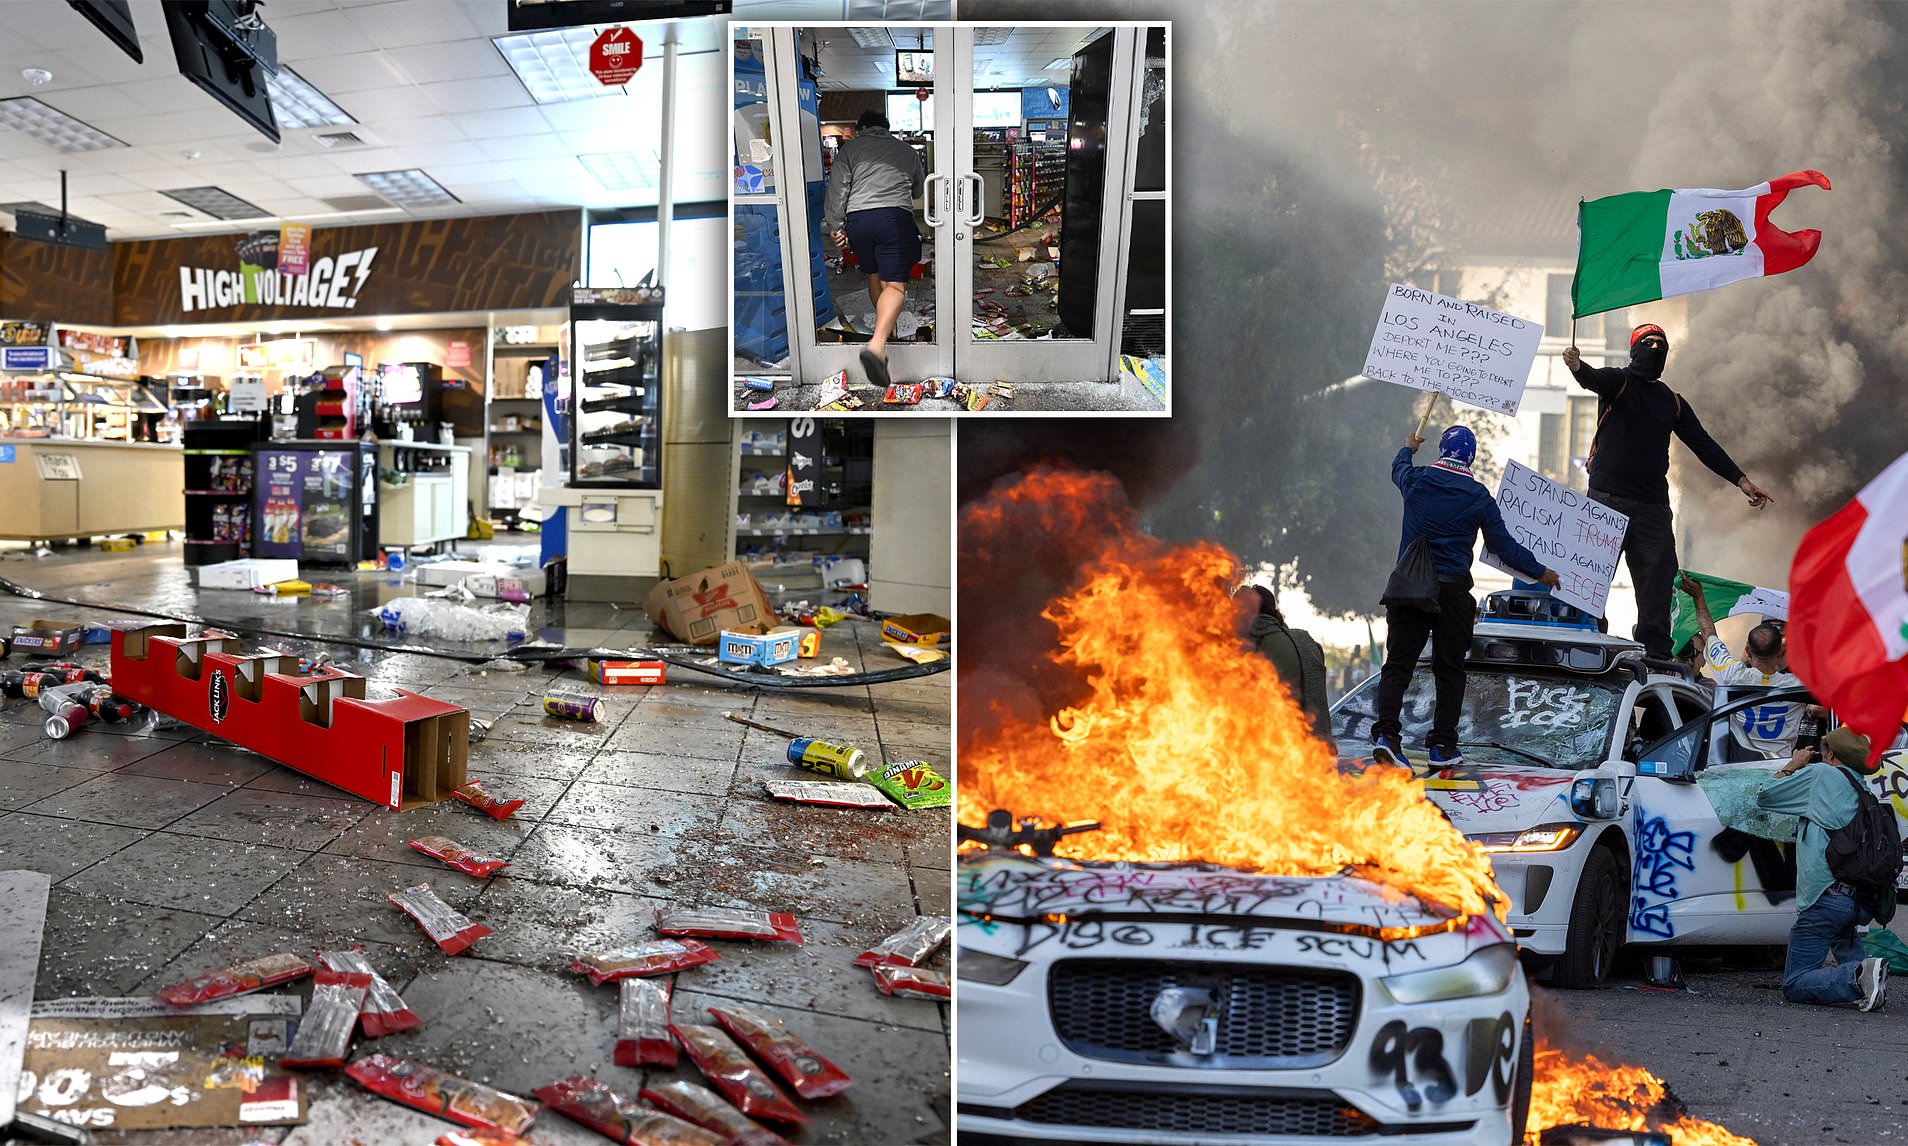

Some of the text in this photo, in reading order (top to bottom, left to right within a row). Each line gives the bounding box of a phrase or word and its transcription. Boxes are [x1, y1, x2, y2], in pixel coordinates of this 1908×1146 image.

[602, 42, 630, 56] SMILE
[179, 247, 379, 312] HIGH VOLTAGE!
[1392, 286, 1526, 330] BORN AND RAISED
[1438, 313, 1457, 326] IN
[1383, 312, 1514, 357] LOS ANGELES
[1383, 331, 1432, 350] DEPORT
[1366, 365, 1397, 380] BACK
[1421, 376, 1442, 390] THE
[1373, 346, 1418, 362] WHERE
[1424, 354, 1445, 366] YOU
[1447, 361, 1478, 377] GOING
[1478, 369, 1488, 379] TO
[1413, 365, 1431, 375] ME
[279, 455, 297, 472] $5
[1505, 463, 1520, 486] I
[1525, 475, 1577, 507] STAND
[1581, 501, 1629, 535] AGAINST
[1514, 525, 1614, 582] STAND AGAINST
[1573, 518, 1623, 557] TRUMP
[1566, 571, 1605, 608] ICE
[1189, 923, 1275, 949] ICE
[1296, 935, 1426, 964] SCUM
